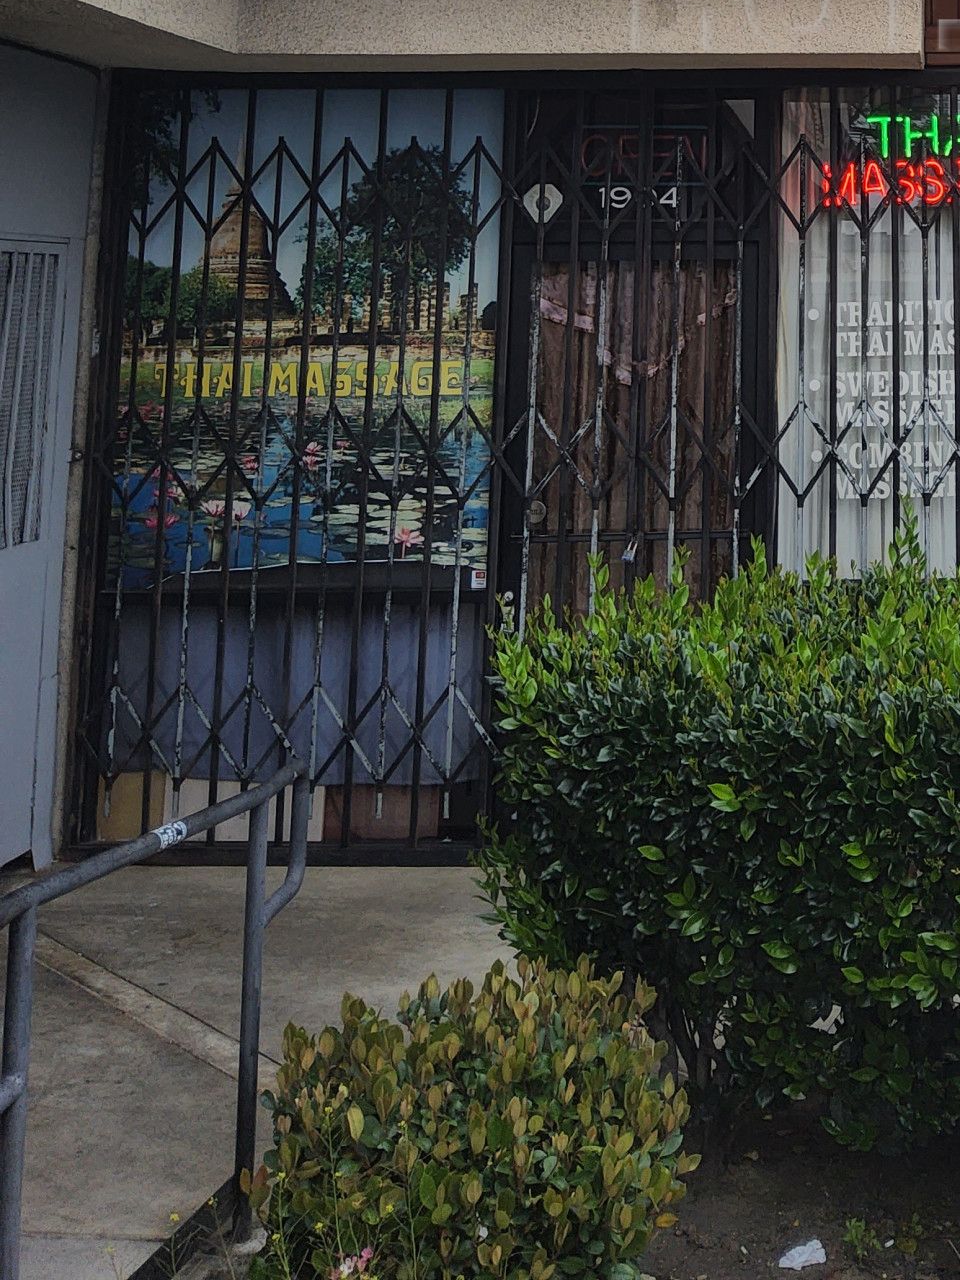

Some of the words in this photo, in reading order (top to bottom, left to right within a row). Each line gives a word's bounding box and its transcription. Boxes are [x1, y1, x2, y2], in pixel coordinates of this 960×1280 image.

[599, 187, 679, 208] 194
[155, 362, 253, 398] THAI
[268, 360, 463, 398] MASSAGE
